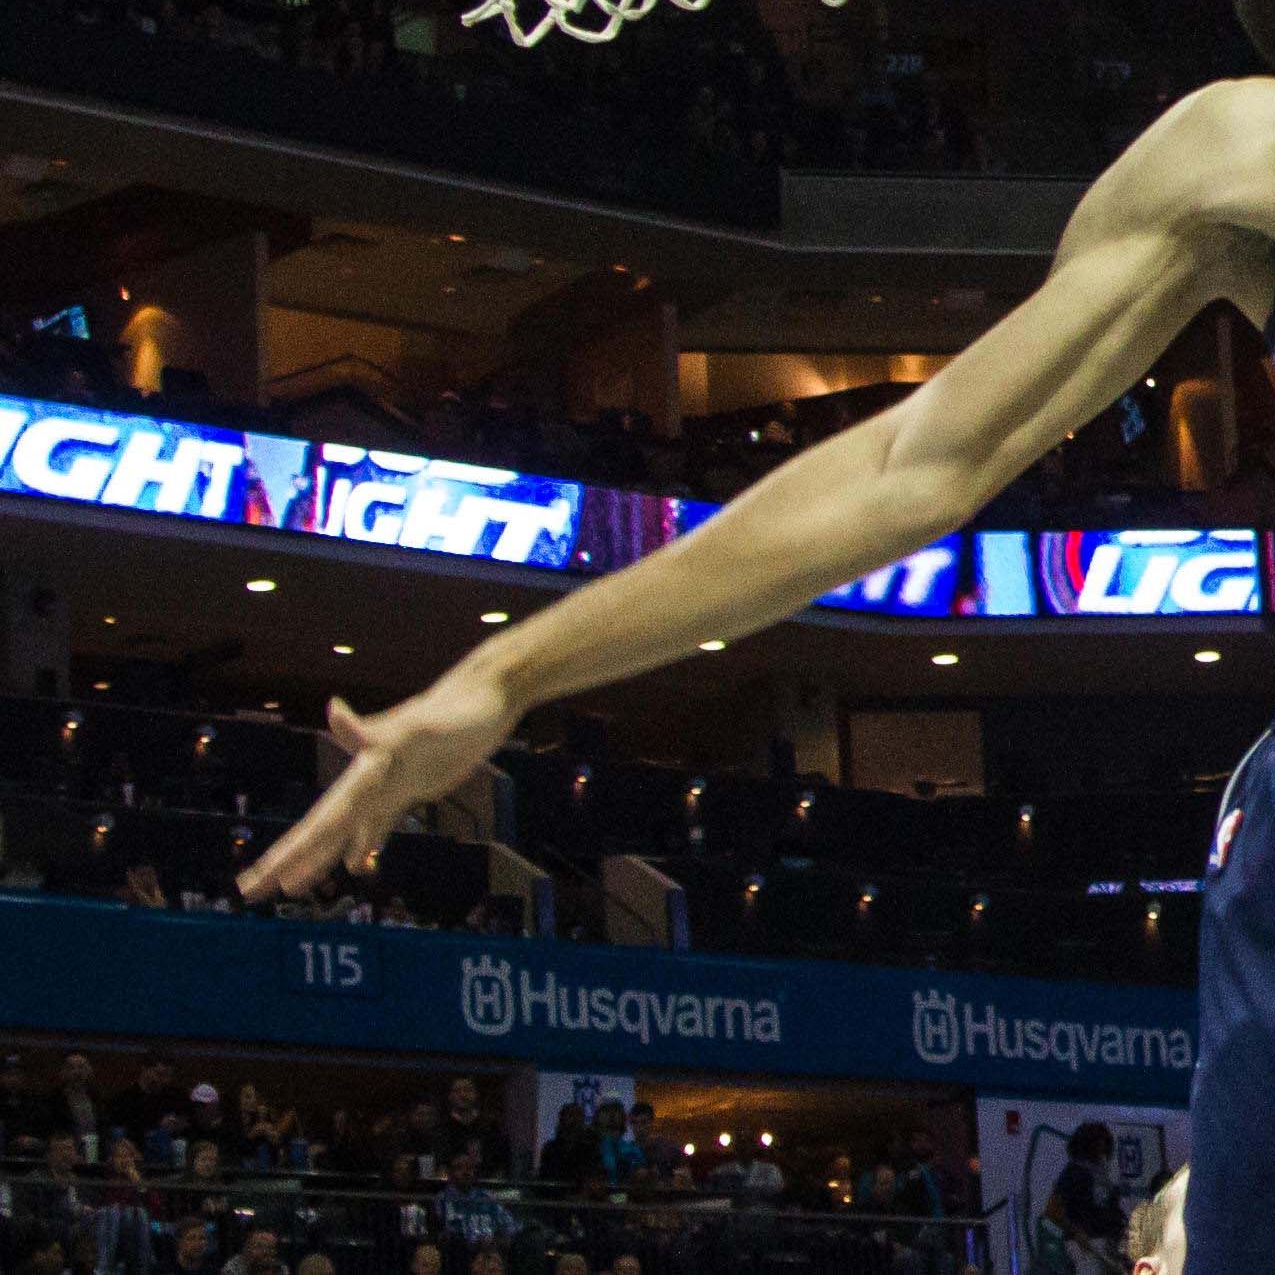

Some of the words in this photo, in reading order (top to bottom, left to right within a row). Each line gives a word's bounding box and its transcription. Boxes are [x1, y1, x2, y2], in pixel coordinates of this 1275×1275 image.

[298, 940, 363, 986] 115
[520, 969, 781, 1045] Husqvarna
[962, 1001, 1193, 1073] Husqvarna
